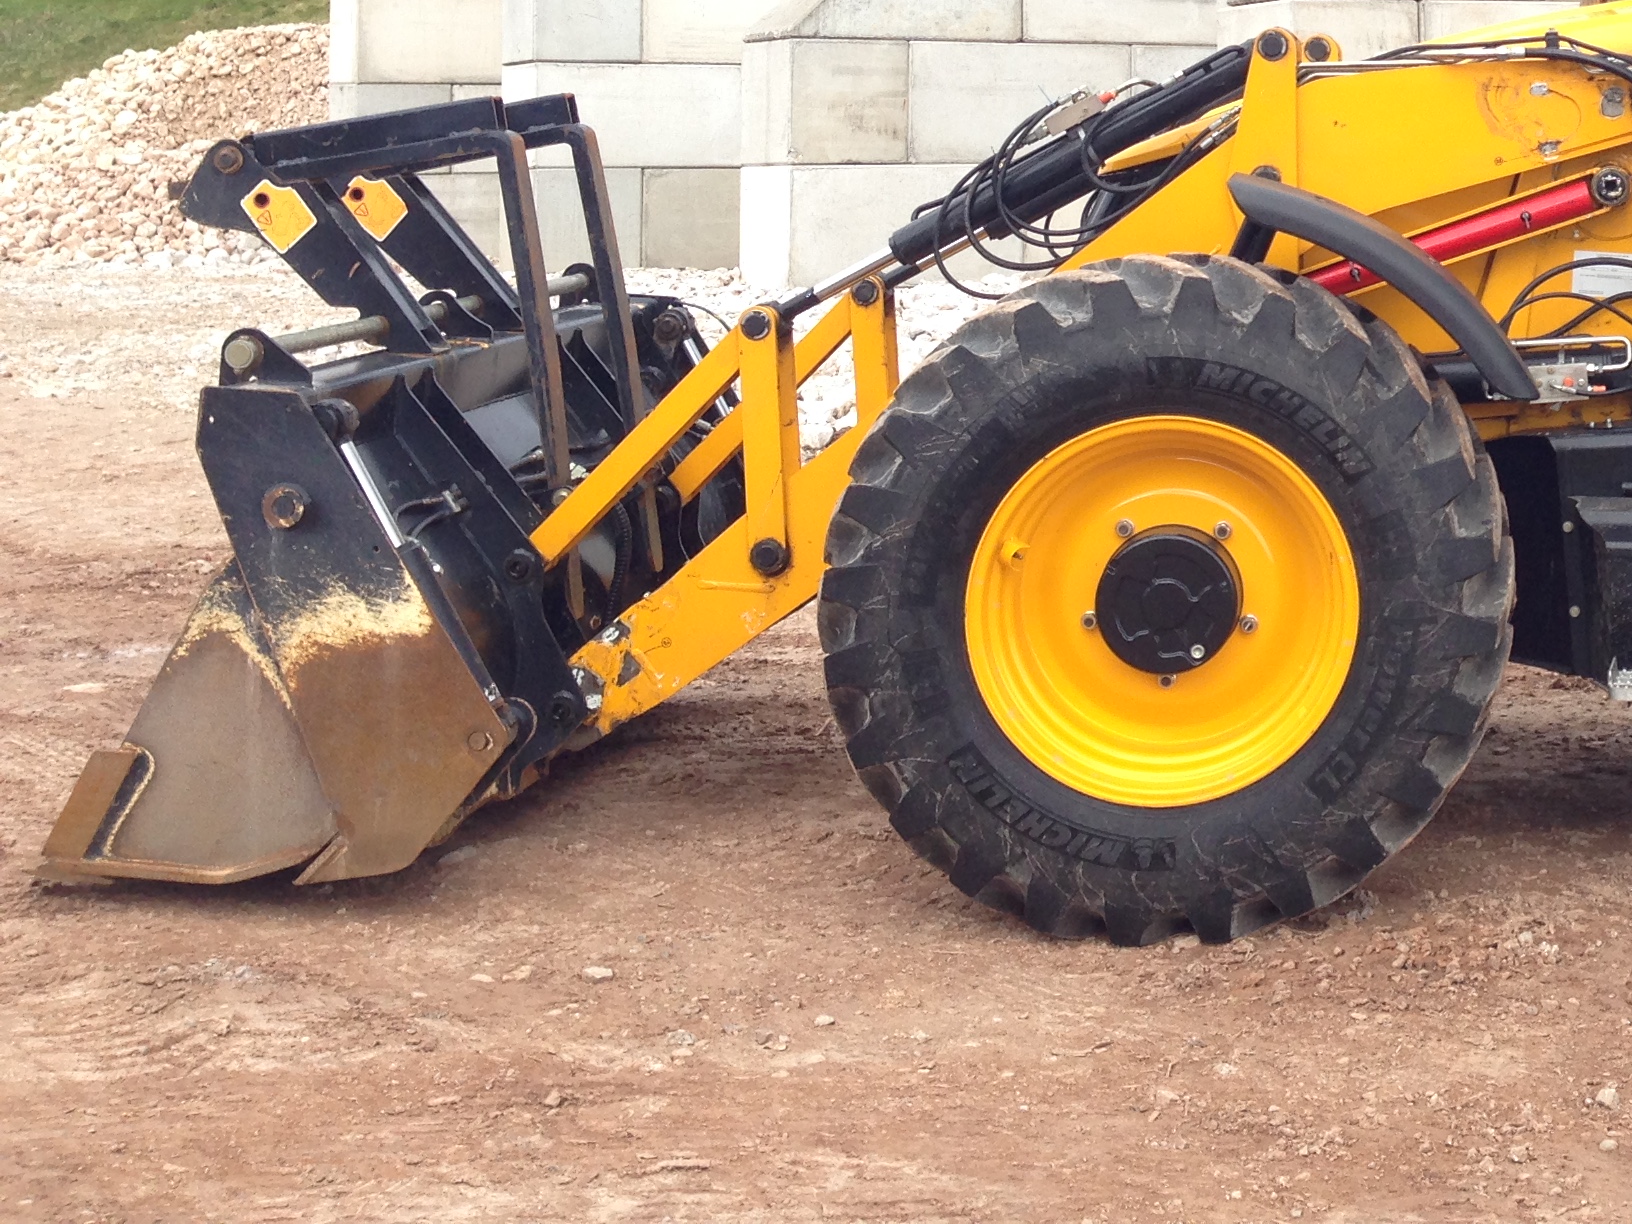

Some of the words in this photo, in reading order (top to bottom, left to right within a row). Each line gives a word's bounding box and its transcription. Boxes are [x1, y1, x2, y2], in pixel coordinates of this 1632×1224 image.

[1198, 361, 1371, 480] MICHELIN
[947, 747, 1128, 871] MICHELIN
[1313, 750, 1361, 798] CL
